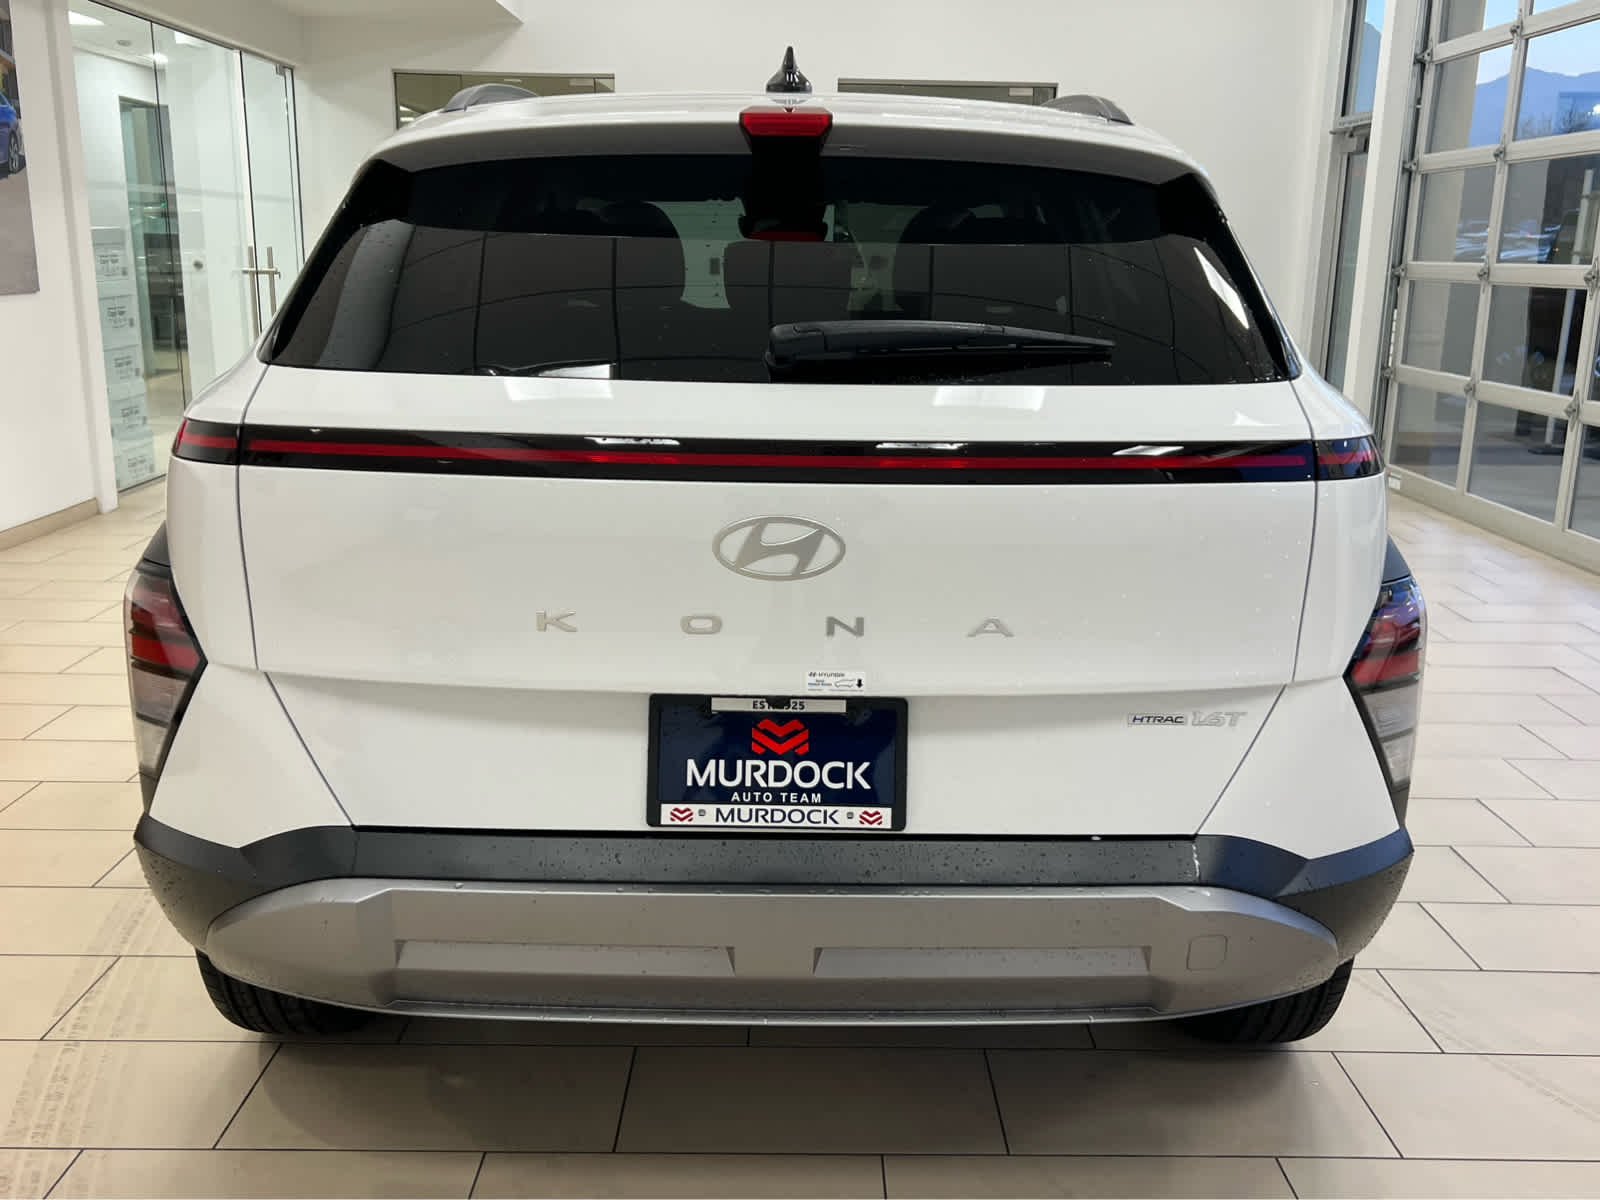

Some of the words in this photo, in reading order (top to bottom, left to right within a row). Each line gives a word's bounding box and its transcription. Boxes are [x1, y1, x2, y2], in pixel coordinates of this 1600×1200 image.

[536, 609, 1014, 638] KONA
[1132, 714, 1185, 724] HTRAC
[686, 758, 872, 790] MURDOCK
[731, 791, 773, 803] AUTO
[780, 792, 822, 804] TEAM
[715, 807, 840, 825] MURDOCK
